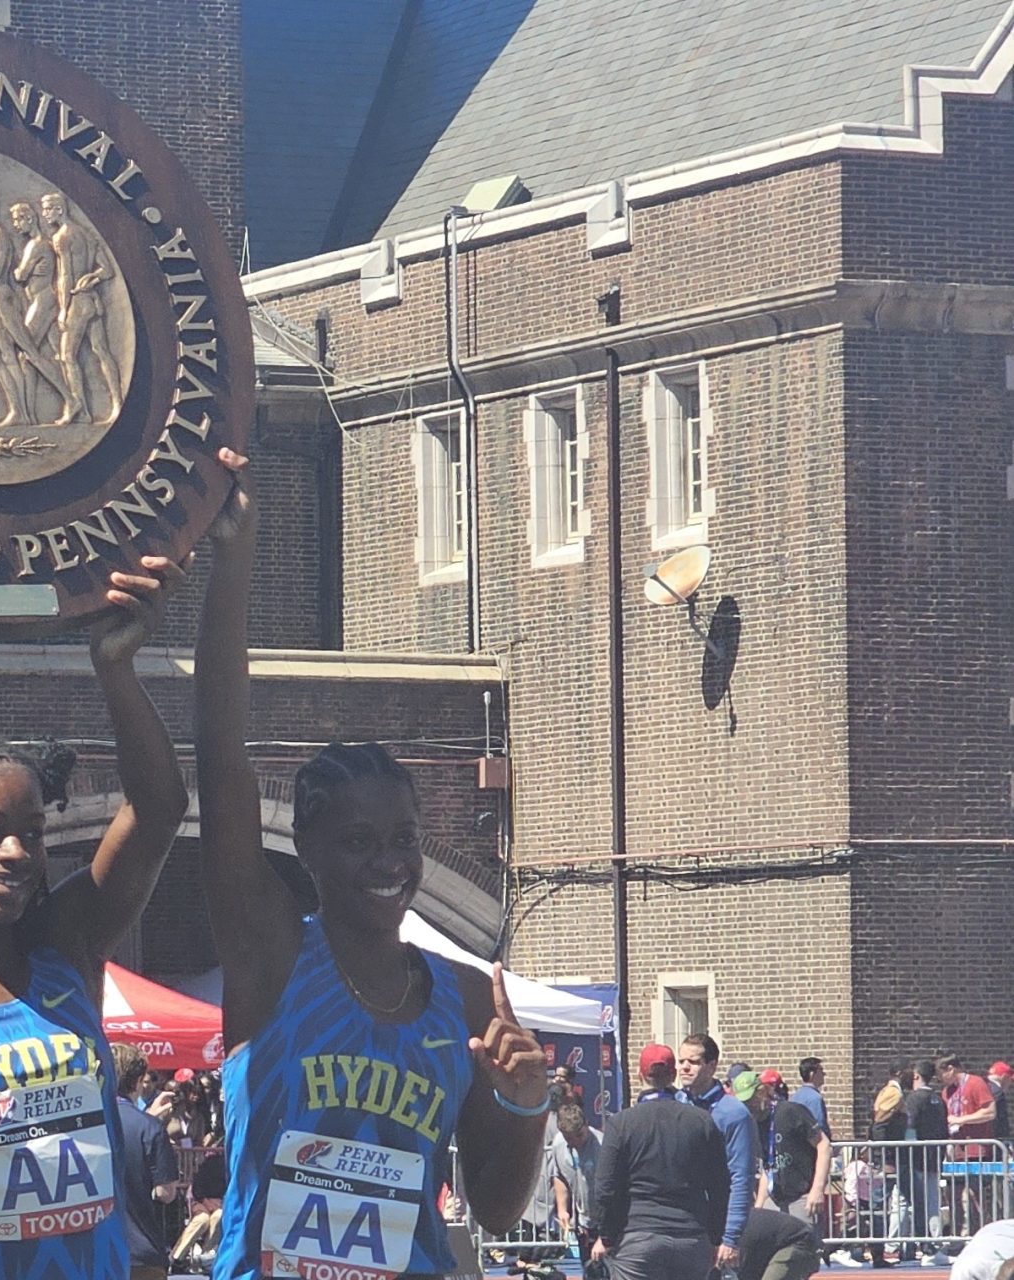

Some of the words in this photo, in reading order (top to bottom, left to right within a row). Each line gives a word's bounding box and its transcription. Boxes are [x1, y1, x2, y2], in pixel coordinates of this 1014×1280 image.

[12, 227, 217, 577] PENNSYLVANIA
[23, 1096, 83, 1119] RELAYS
[24, 1085, 68, 1105] PENN
[301, 1054, 446, 1144] HYDEL
[29, 1126, 48, 1137] On.
[339, 1145, 391, 1165] PENN
[1, 1137, 99, 1211] AA
[294, 1171, 332, 1189] Dream
[333, 1178, 354, 1192] On.
[335, 1156, 404, 1182] RELAYS
[26, 1206, 106, 1234] TOYOTA
[281, 1193, 388, 1266] AA
